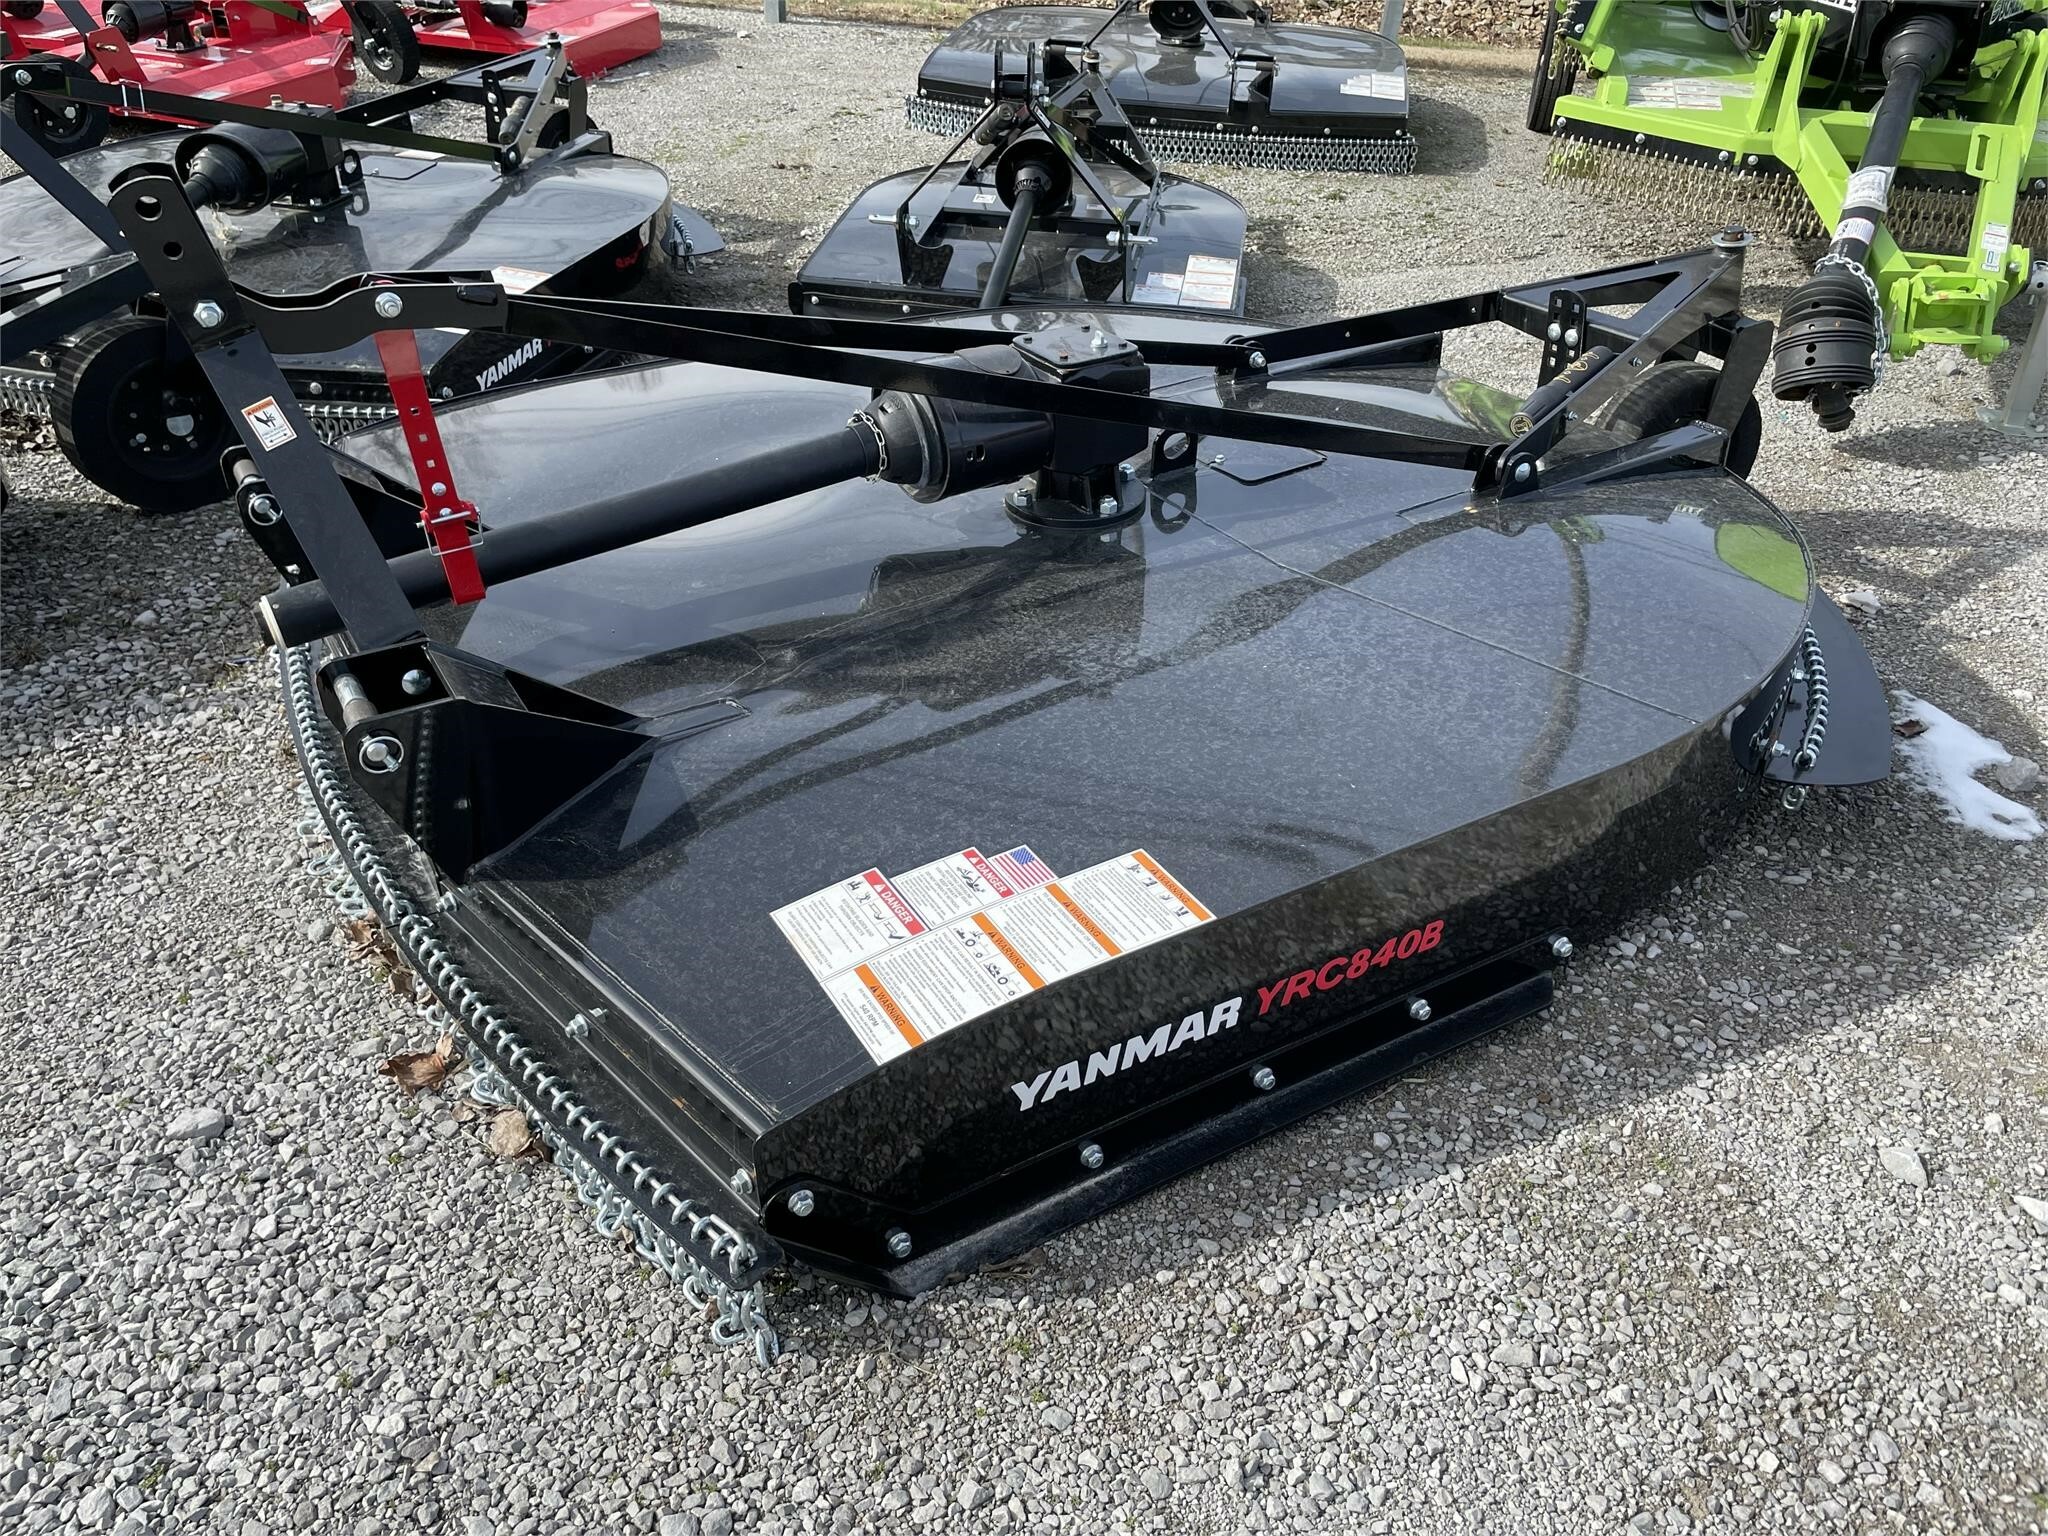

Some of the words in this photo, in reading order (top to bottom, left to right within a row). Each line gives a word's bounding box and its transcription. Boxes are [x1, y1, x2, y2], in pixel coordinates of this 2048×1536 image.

[476, 338, 542, 391] YANMAR
[975, 863, 1007, 892] DANGER
[1155, 874, 1190, 903] WARNING
[880, 890, 914, 924] DANGER
[1068, 907, 1102, 937] WARNING
[993, 937, 1025, 969] WARNING
[858, 1003, 870, 1014] 540
[866, 1013, 879, 1027] RPM
[875, 991, 906, 1027] WARNING
[1010, 996, 1244, 1112] YANMAR
[1257, 919, 1444, 1016] YRC840B
